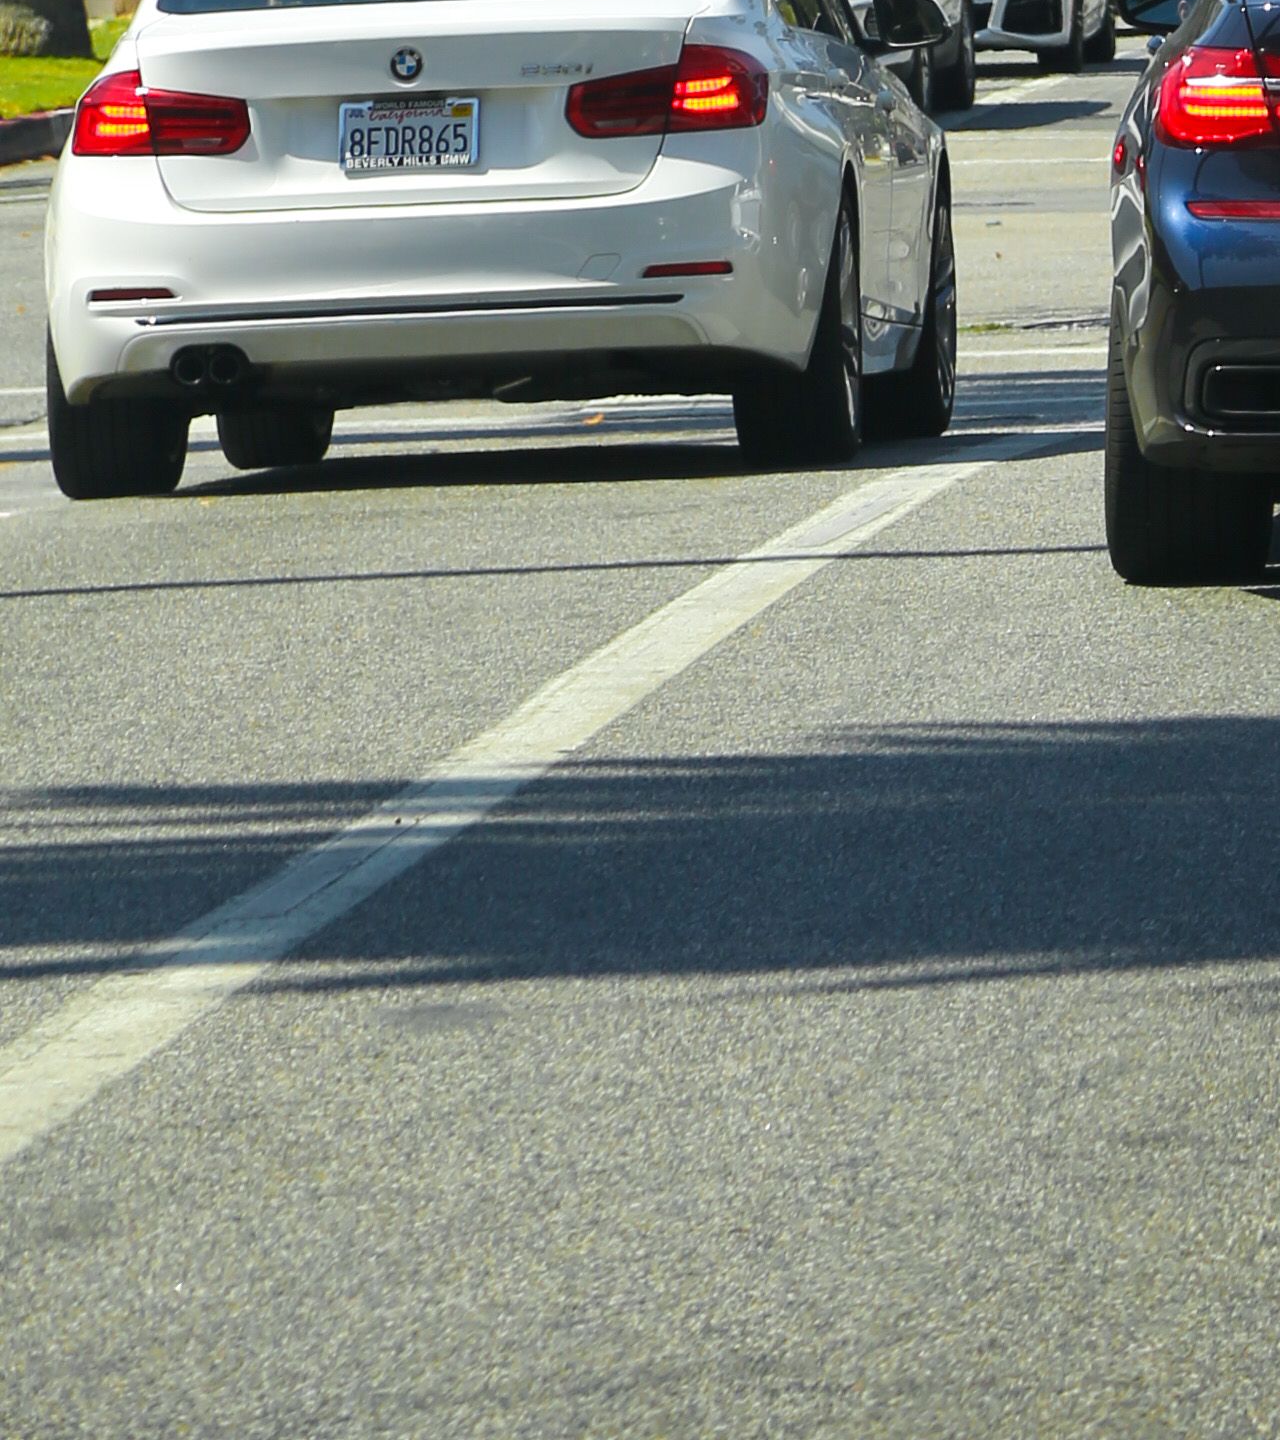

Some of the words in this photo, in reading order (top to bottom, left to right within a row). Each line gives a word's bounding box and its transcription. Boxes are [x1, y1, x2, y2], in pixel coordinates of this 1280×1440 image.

[349, 123, 468, 157] 8FDR865
[345, 155, 400, 169] BEVERLY
[403, 154, 437, 167] HILLS
[440, 153, 470, 166] BMW
